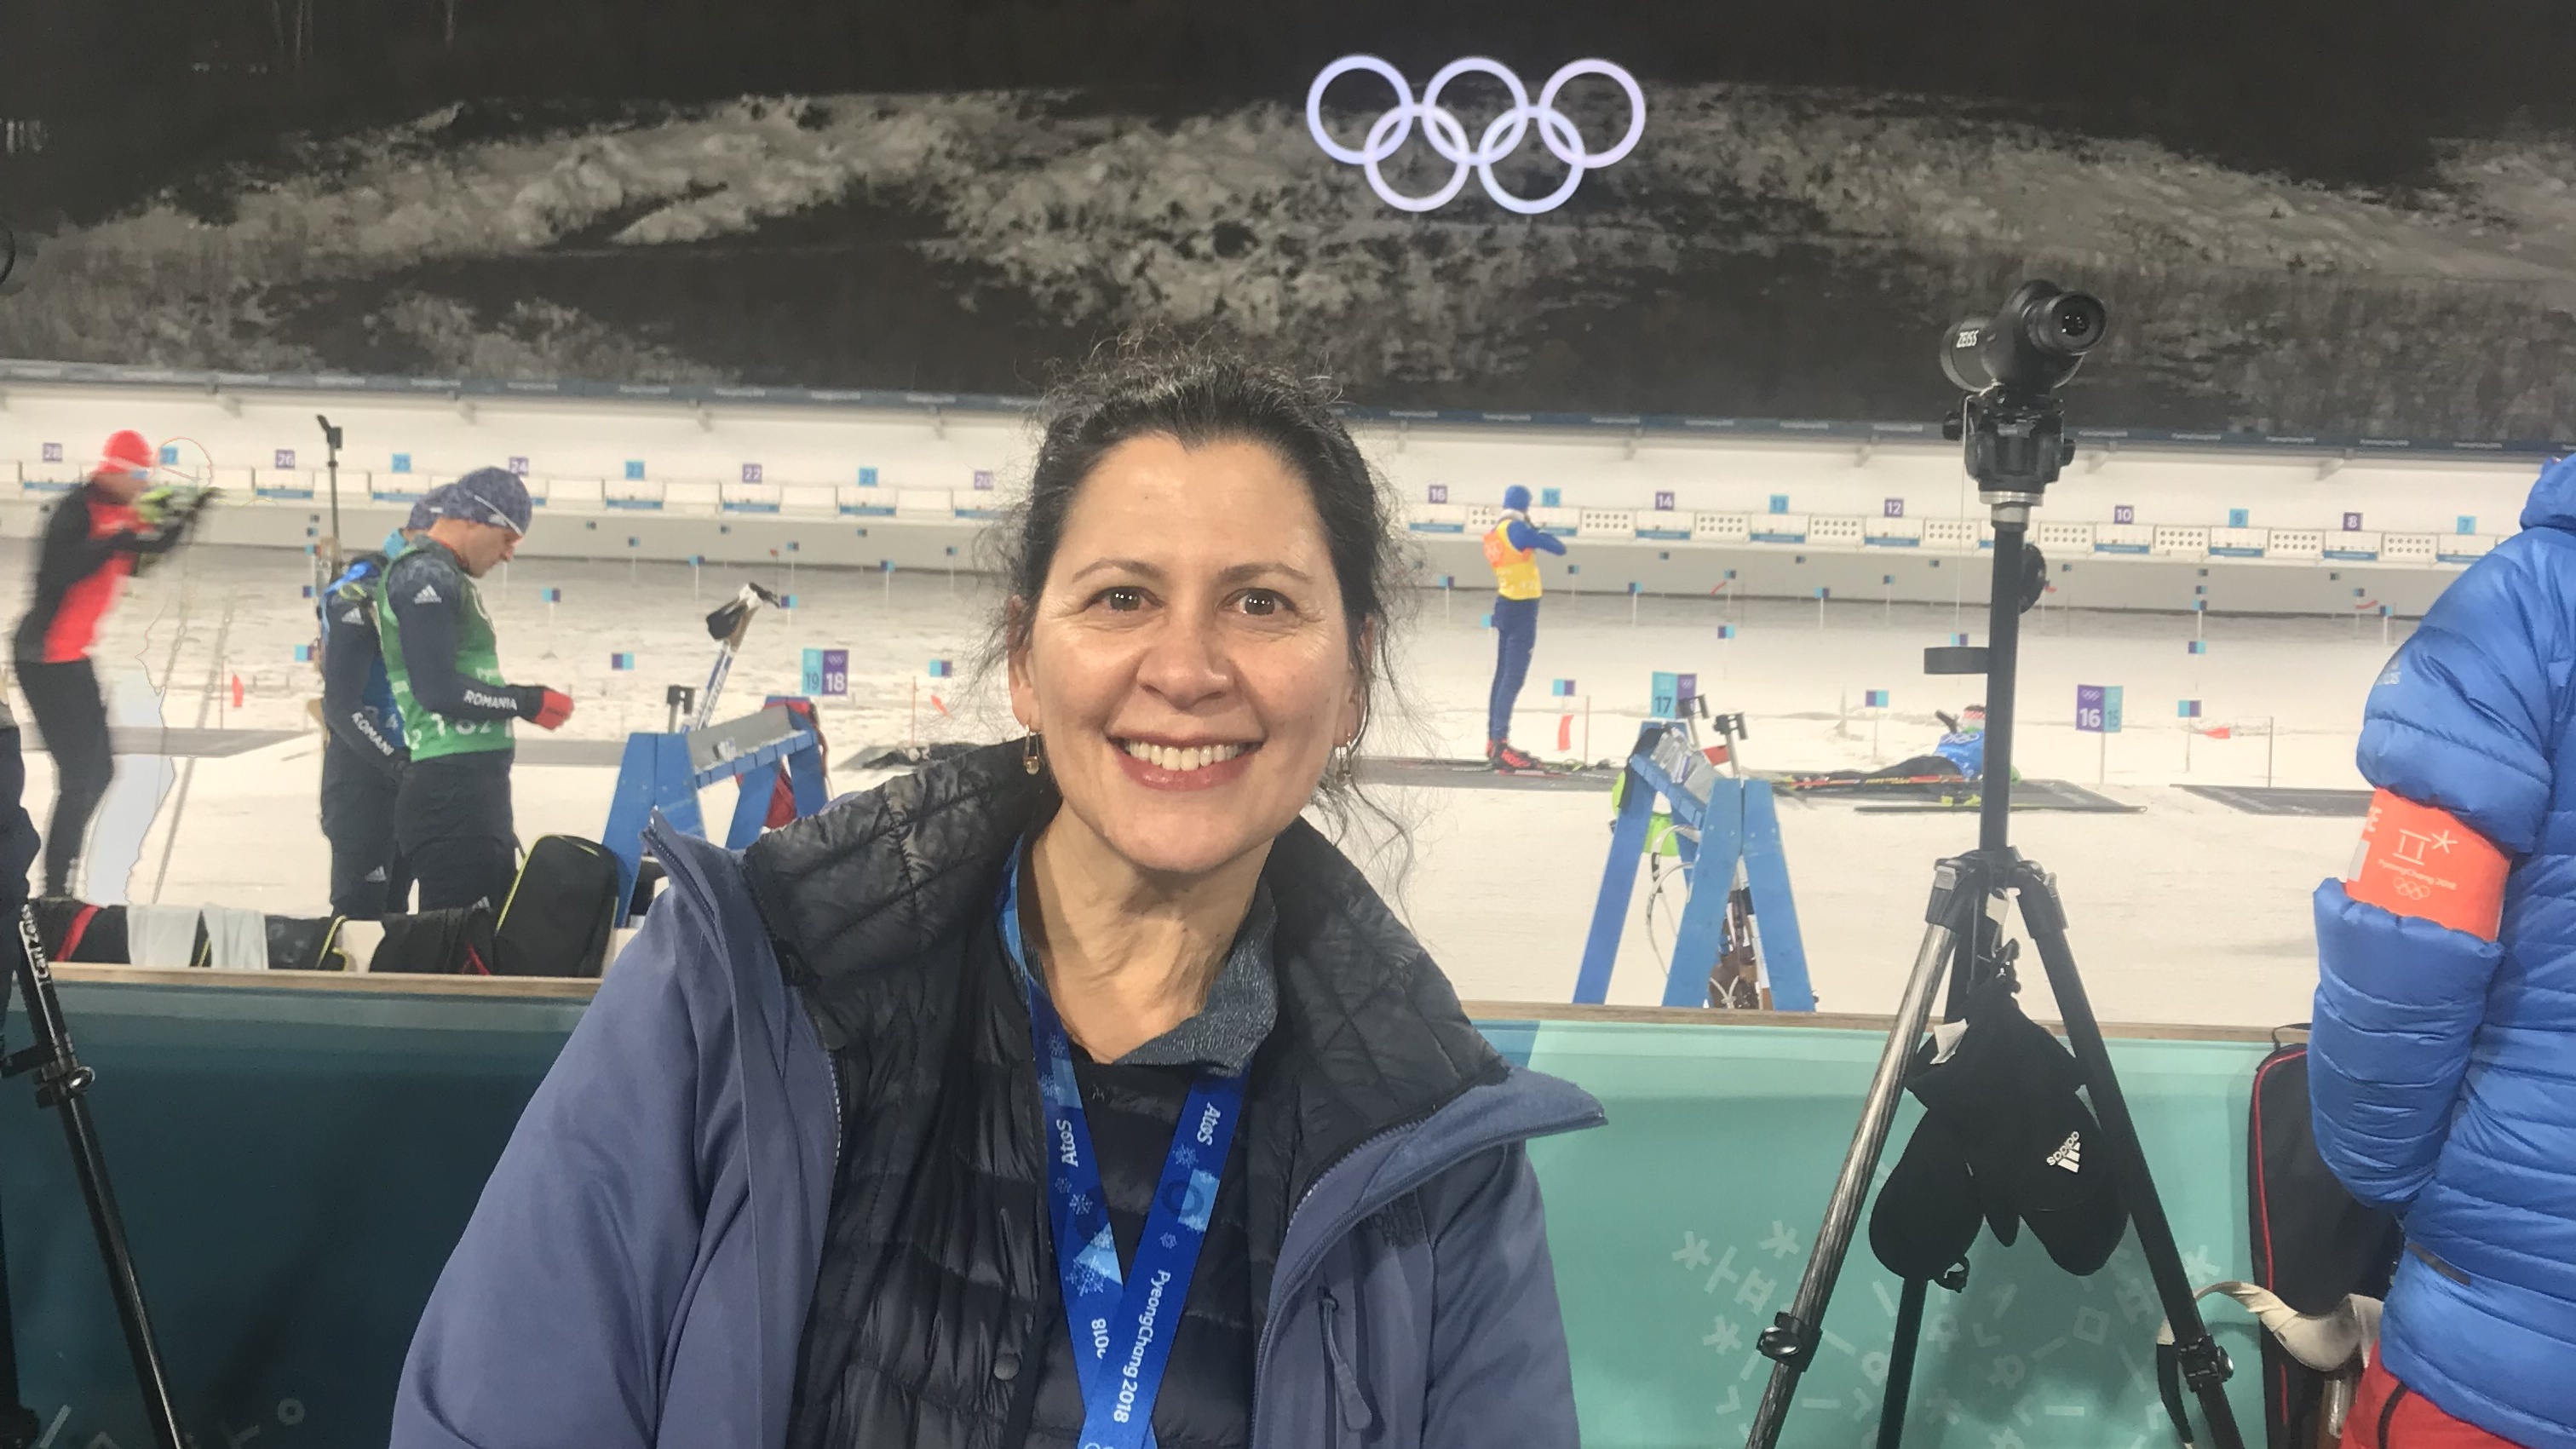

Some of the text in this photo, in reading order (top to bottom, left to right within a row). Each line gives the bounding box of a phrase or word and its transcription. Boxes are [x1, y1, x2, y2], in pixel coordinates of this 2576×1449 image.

[278, 453, 295, 465] 26
[745, 467, 761, 480] 22
[976, 474, 993, 487] 20
[1431, 488, 1446, 501] 16
[1659, 495, 1672, 508] 14
[1888, 501, 1901, 515] 12
[2118, 508, 2132, 521] 10
[2234, 512, 2243, 524] 9
[2347, 515, 2358, 528] 8
[2461, 519, 2470, 531] 7
[805, 672, 819, 690] 19
[825, 672, 845, 692] 18
[463, 689, 518, 711] ROMANIA
[1654, 695, 1672, 714] 17
[2079, 707, 2102, 728] 16
[2107, 710, 2119, 728] 15
[1197, 1101, 1222, 1146] Atos
[1056, 1118, 1079, 1167] Atos
[2046, 1130, 2080, 1166] adidas
[1113, 1269, 1171, 1423] PyeongChang 2018
